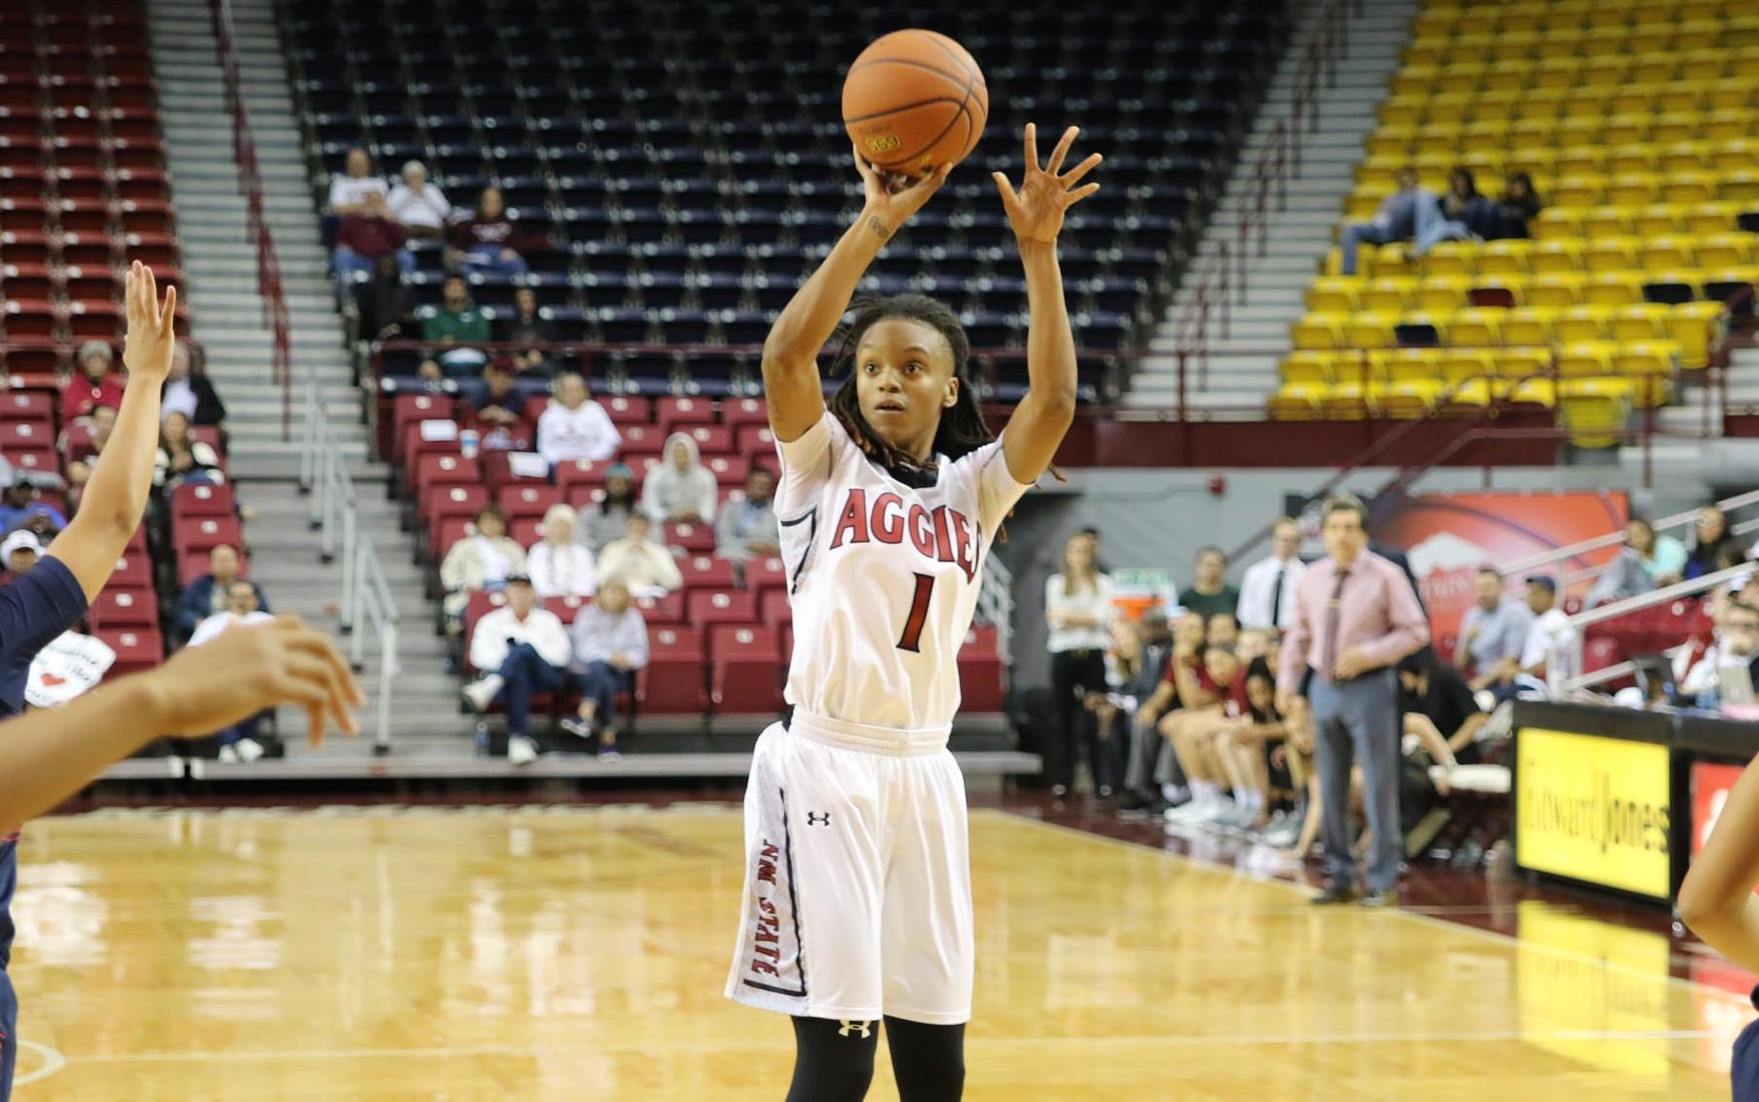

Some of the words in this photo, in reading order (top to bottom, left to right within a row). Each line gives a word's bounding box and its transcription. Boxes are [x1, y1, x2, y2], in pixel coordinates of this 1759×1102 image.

[830, 488, 983, 585] AGGIE
[896, 571, 935, 653] 1
[1599, 772, 1670, 855] Jones
[757, 838, 780, 886] NM
[751, 896, 781, 978] STATE
